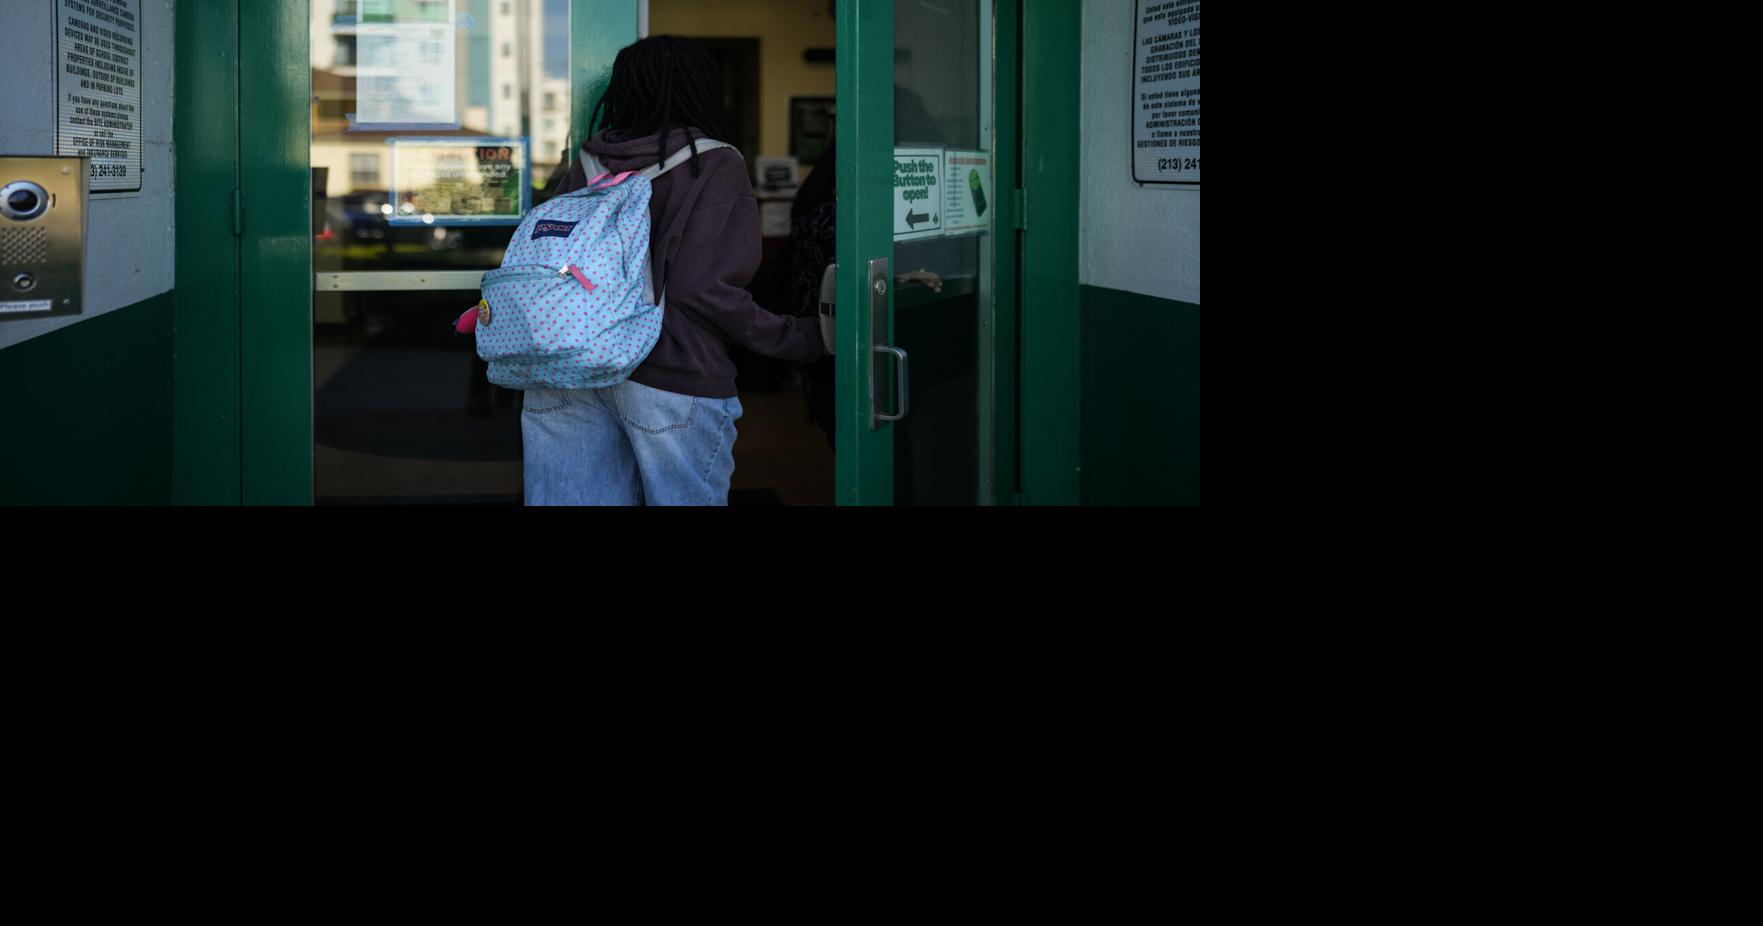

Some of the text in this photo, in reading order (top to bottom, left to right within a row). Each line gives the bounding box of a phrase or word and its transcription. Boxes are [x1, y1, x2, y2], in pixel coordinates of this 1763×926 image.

[86, 7, 95, 16] FOR
[96, 10, 115, 24] SECURITY
[120, 9, 135, 21] CAMERA
[1143, 16, 1153, 24] que
[1168, 6, 1194, 18] equipada
[1146, 6, 1160, 14] Usted
[68, 16, 133, 46] CAMERAS AND VIDEO RECORDING
[65, 27, 135, 56] DEVICES MAY BE USED THROUGHOUT
[1143, 37, 1153, 46] LAS
[1155, 31, 1182, 44] CÁMARAS
[1151, 41, 1183, 54] GRABACIÓN
[1186, 39, 1196, 48] DEL
[75, 42, 129, 65] AREAS OF SCHOOL DISTRICT
[1146, 51, 1187, 64] DISTRIBUIDOS
[68, 52, 134, 77] PROPERTIES INCLUDING INSIDE OF
[1142, 64, 1160, 74] TODOS
[1162, 62, 1173, 71] LOS
[93, 70, 110, 82] OUTSIDE
[111, 74, 115, 82] OF
[116, 76, 135, 88] BUILDINGS
[1142, 72, 1177, 83] INCLUYENDO
[1179, 70, 1191, 79] SUS
[81, 80, 89, 89] AND
[90, 81, 95, 90] IN
[96, 82, 113, 94] PARKING
[1141, 93, 1147, 101] Si
[1149, 92, 1163, 100] usted
[1165, 90, 1179, 98] tiene
[72, 95, 80, 104] you
[81, 96, 91, 105] have
[100, 101, 118, 111] questions
[1165, 100, 1186, 108] sistema
[90, 108, 100, 117] these
[101, 111, 117, 119] systems
[117, 113, 128, 121] please
[70, 117, 86, 125] contact
[94, 119, 103, 127] SITE
[104, 120, 133, 130] ADMINISTRATOR
[73, 137, 131, 149] OFFICE OF RISK MANAGEMENT
[1138, 140, 1168, 149] GESTIONES
[99, 165, 127, 177] 241-3139
[495, 163, 512, 171] any
[894, 160, 919, 173] Push
[919, 160, 934, 173] the
[1159, 159, 1182, 172] (213)
[927, 174, 936, 186] to
[903, 186, 929, 204] open!
[29, 303, 49, 311] push
